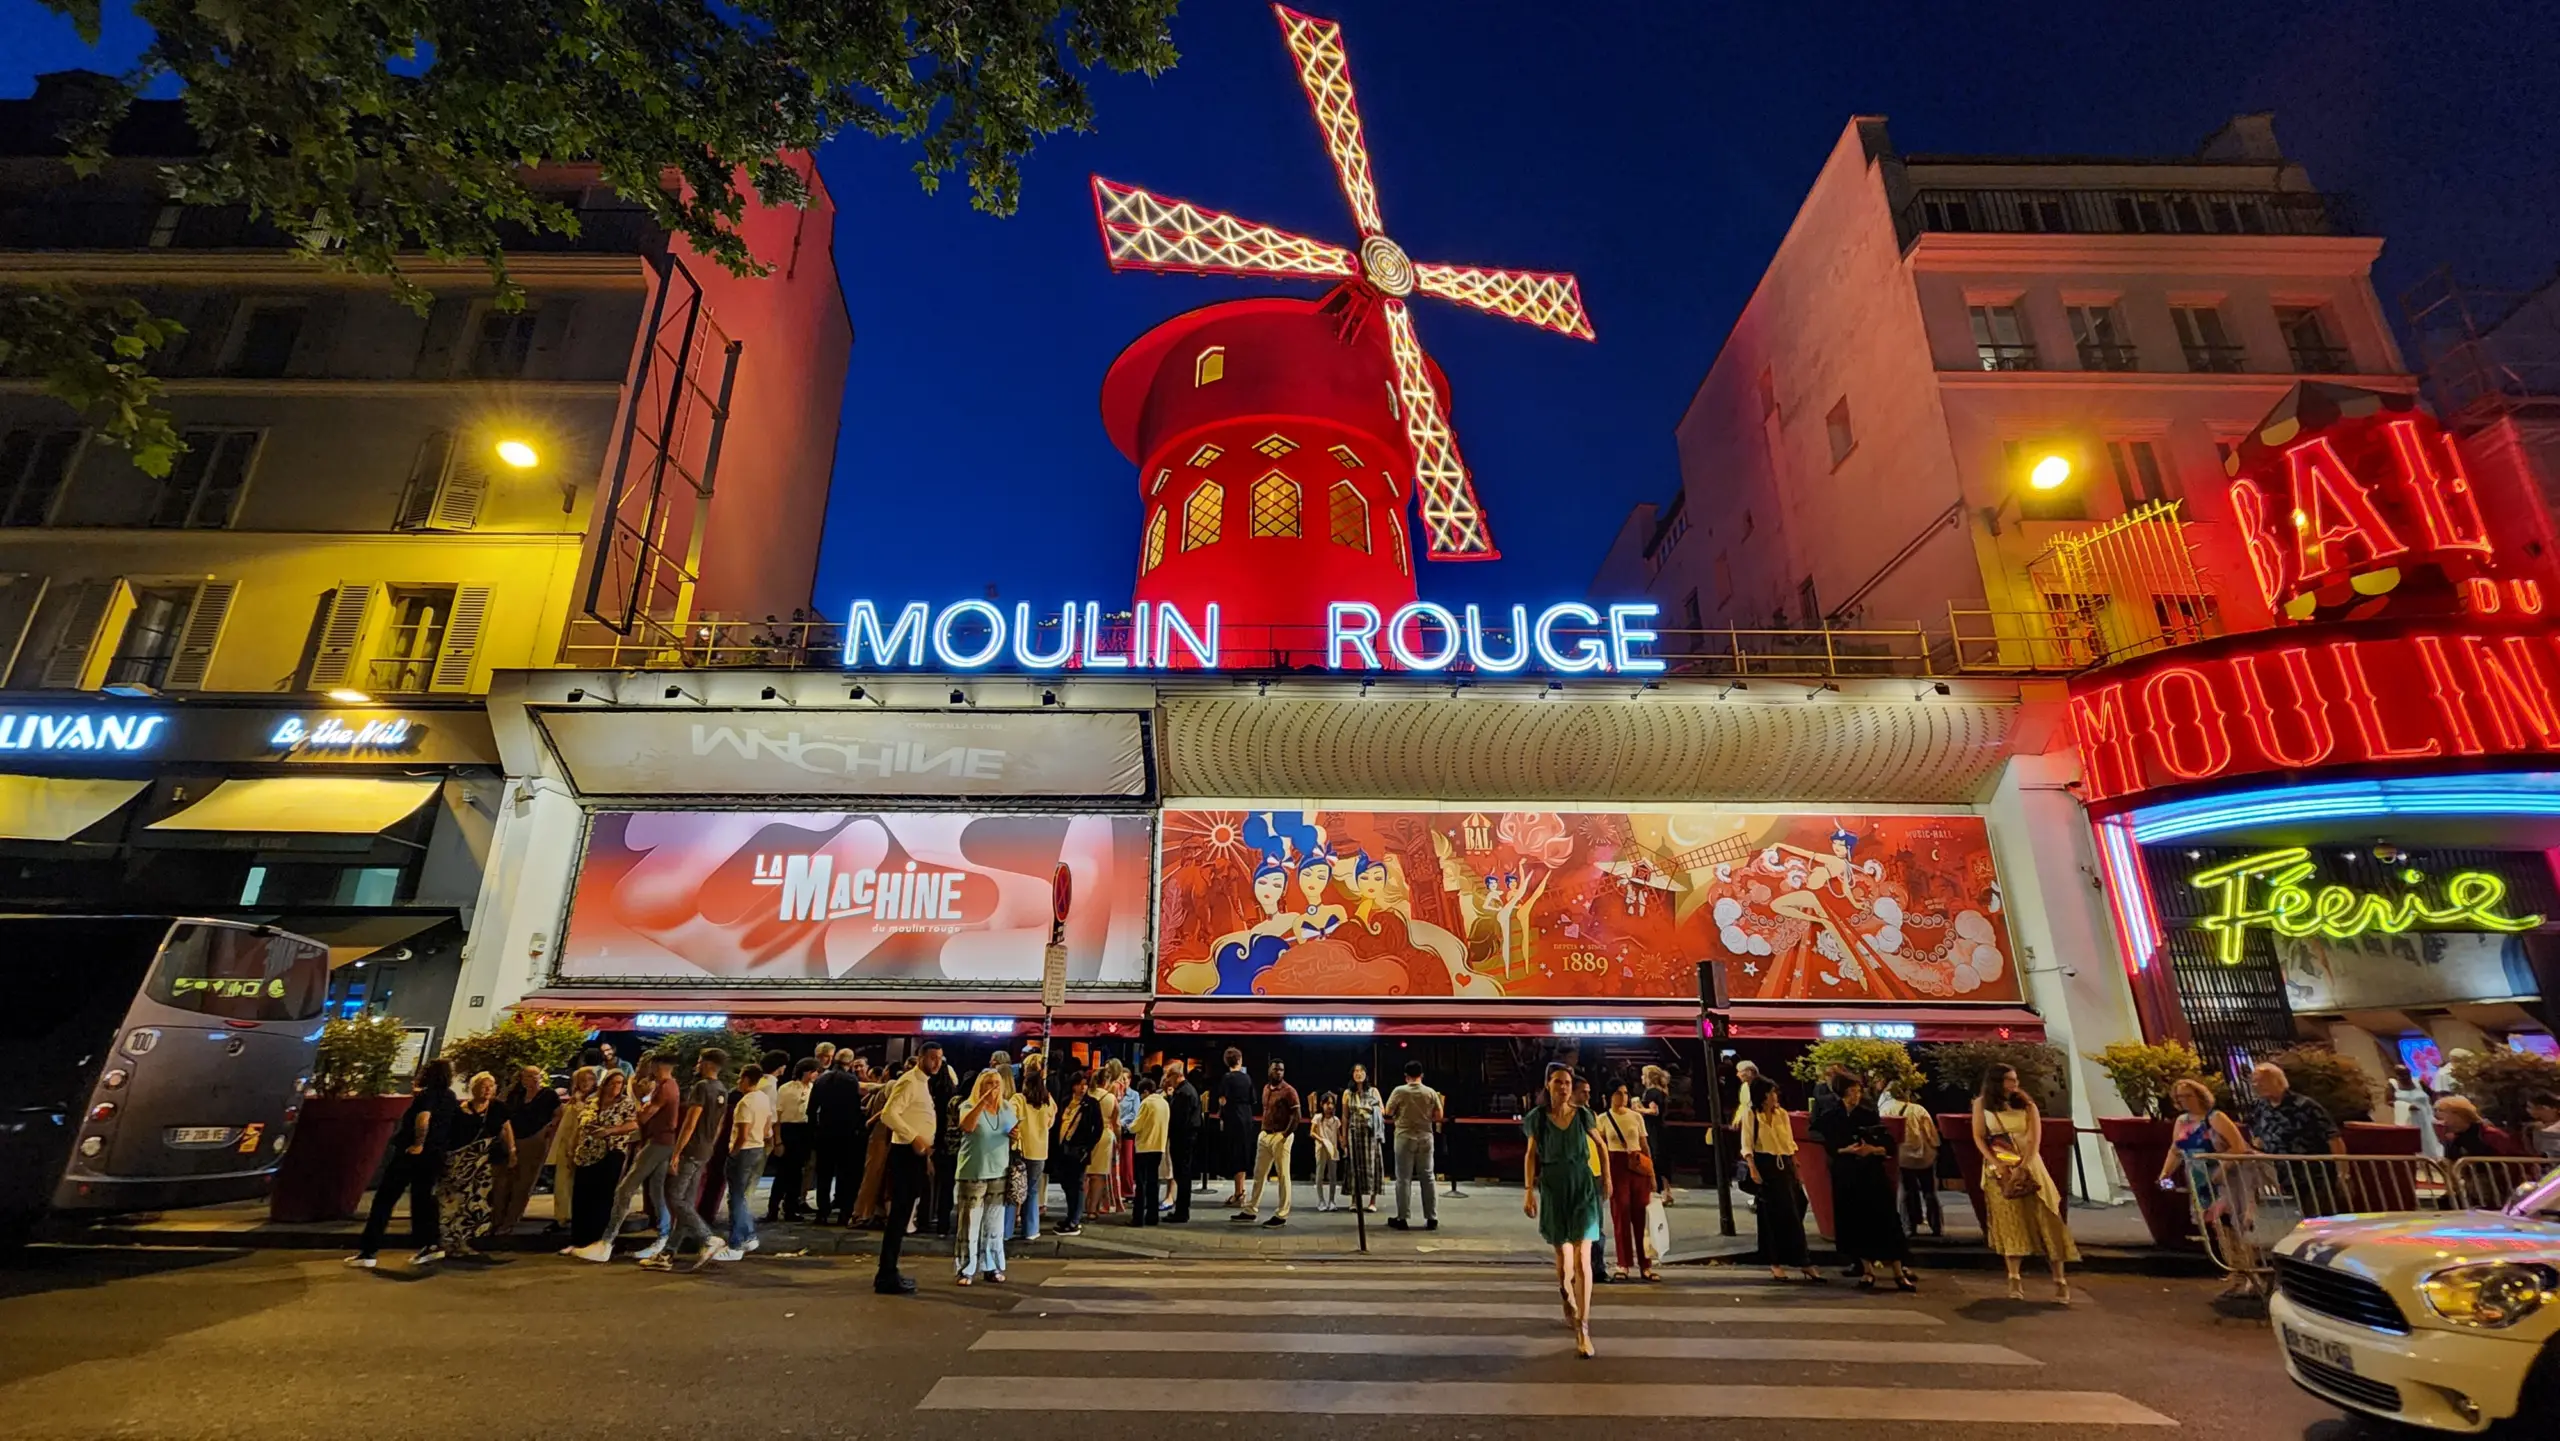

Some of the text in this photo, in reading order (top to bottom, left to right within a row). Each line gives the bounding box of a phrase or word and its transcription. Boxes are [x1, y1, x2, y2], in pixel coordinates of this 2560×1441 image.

[2229, 419, 2494, 611] BAL
[2468, 577, 2543, 615] DU
[843, 600, 1667, 672] MOULIN ROUGE
[2069, 635, 2560, 802] MOULIN
[0, 714, 165, 750] LIVANS
[271, 717, 412, 751] By the Mill
[1464, 827, 1493, 851] BAL
[754, 854, 783, 877] LA
[2192, 847, 2546, 965] Féerie
[872, 924, 962, 934] du moulin rouge
[1562, 952, 1609, 977] 1889
[636, 1014, 728, 1028] MOULIN ROUGE
[922, 1018, 1015, 1032] MOULIN ROUGE
[1285, 1018, 1375, 1032] MOULIN ROUGE
[1553, 1020, 1645, 1034] MOULIN ROUGE
[131, 1032, 154, 1051] 100
